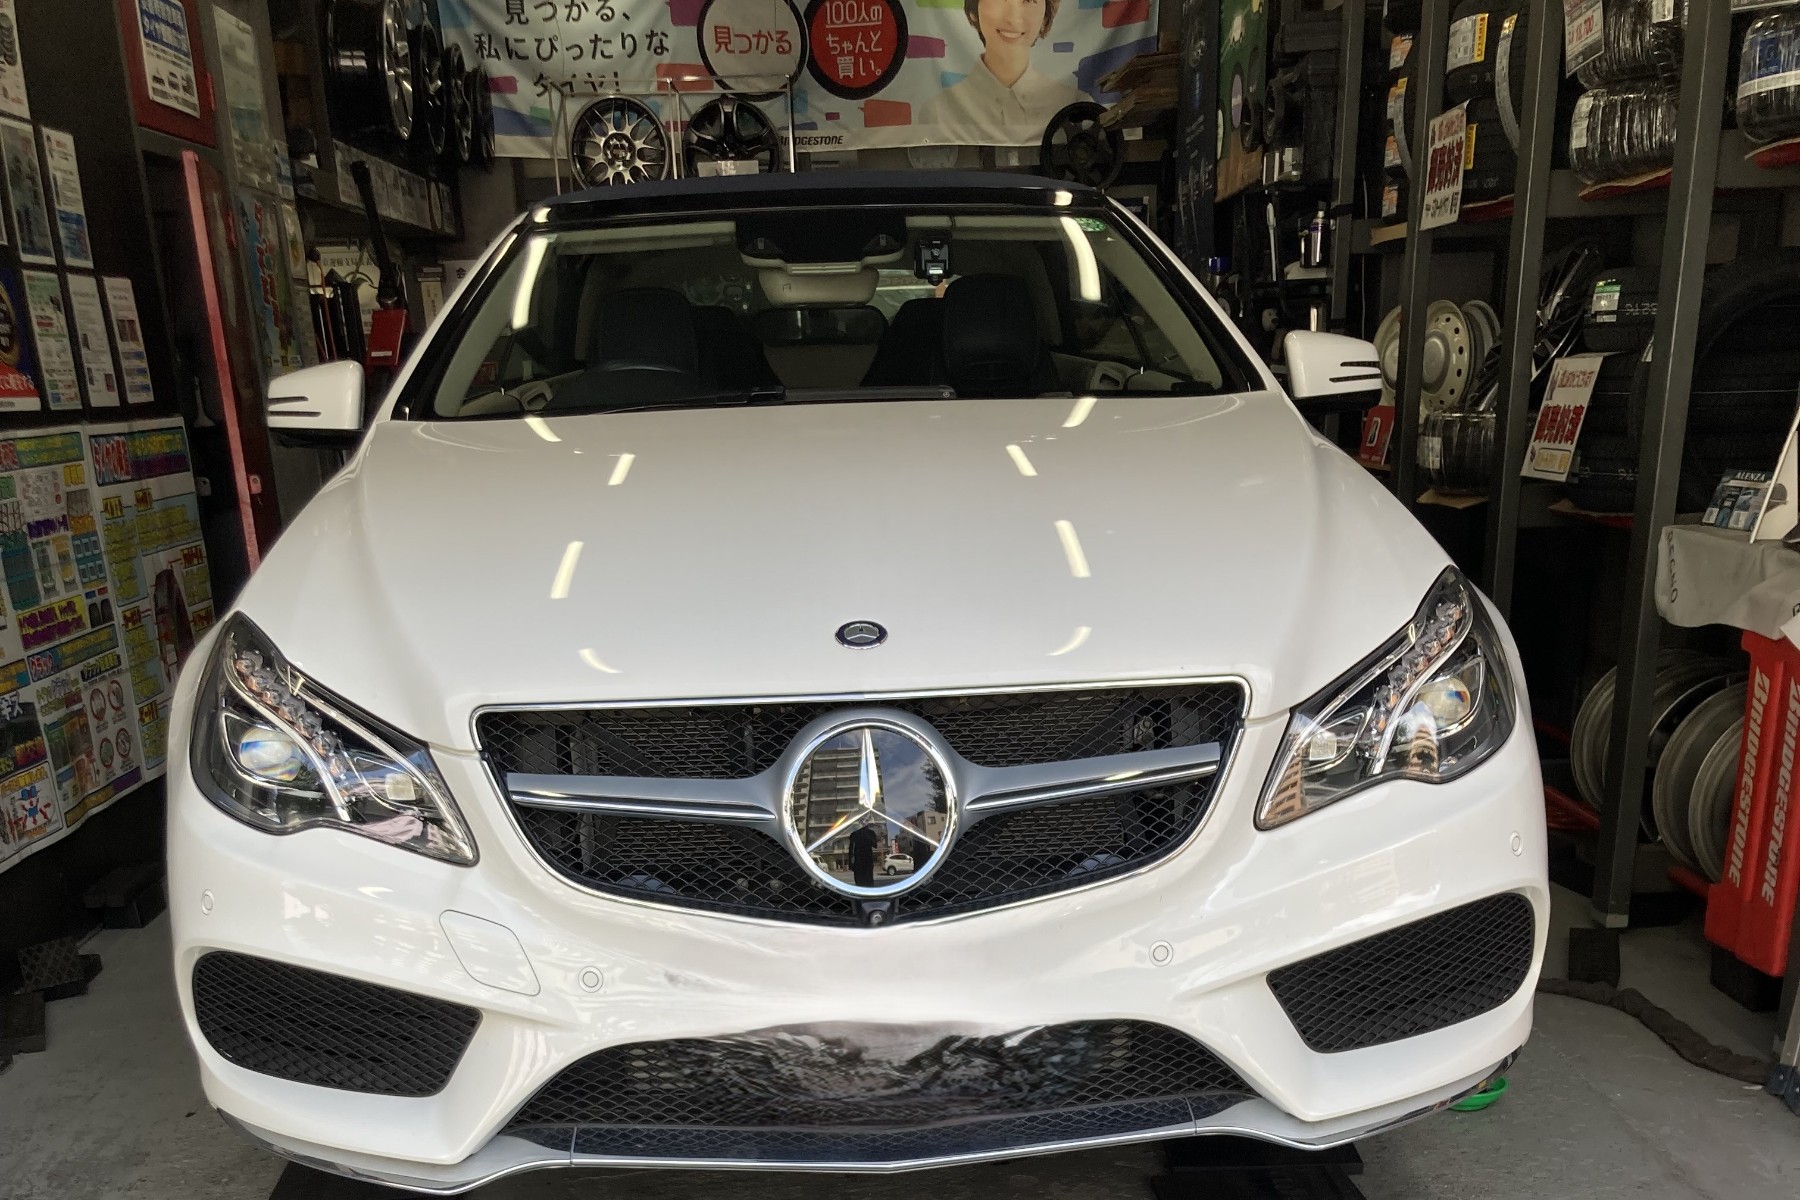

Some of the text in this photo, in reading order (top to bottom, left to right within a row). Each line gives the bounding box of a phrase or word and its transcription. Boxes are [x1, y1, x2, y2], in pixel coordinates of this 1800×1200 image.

[825, 2, 882, 25] 100人の
[474, 29, 669, 62] 私にぴったりな
[714, 25, 792, 55] 見つかる
[826, 30, 882, 55] ちゃんと
[837, 56, 882, 80] 買い。
[1735, 471, 1767, 482] ALENZA
[1729, 666, 1771, 889] BRIDGESTONE
